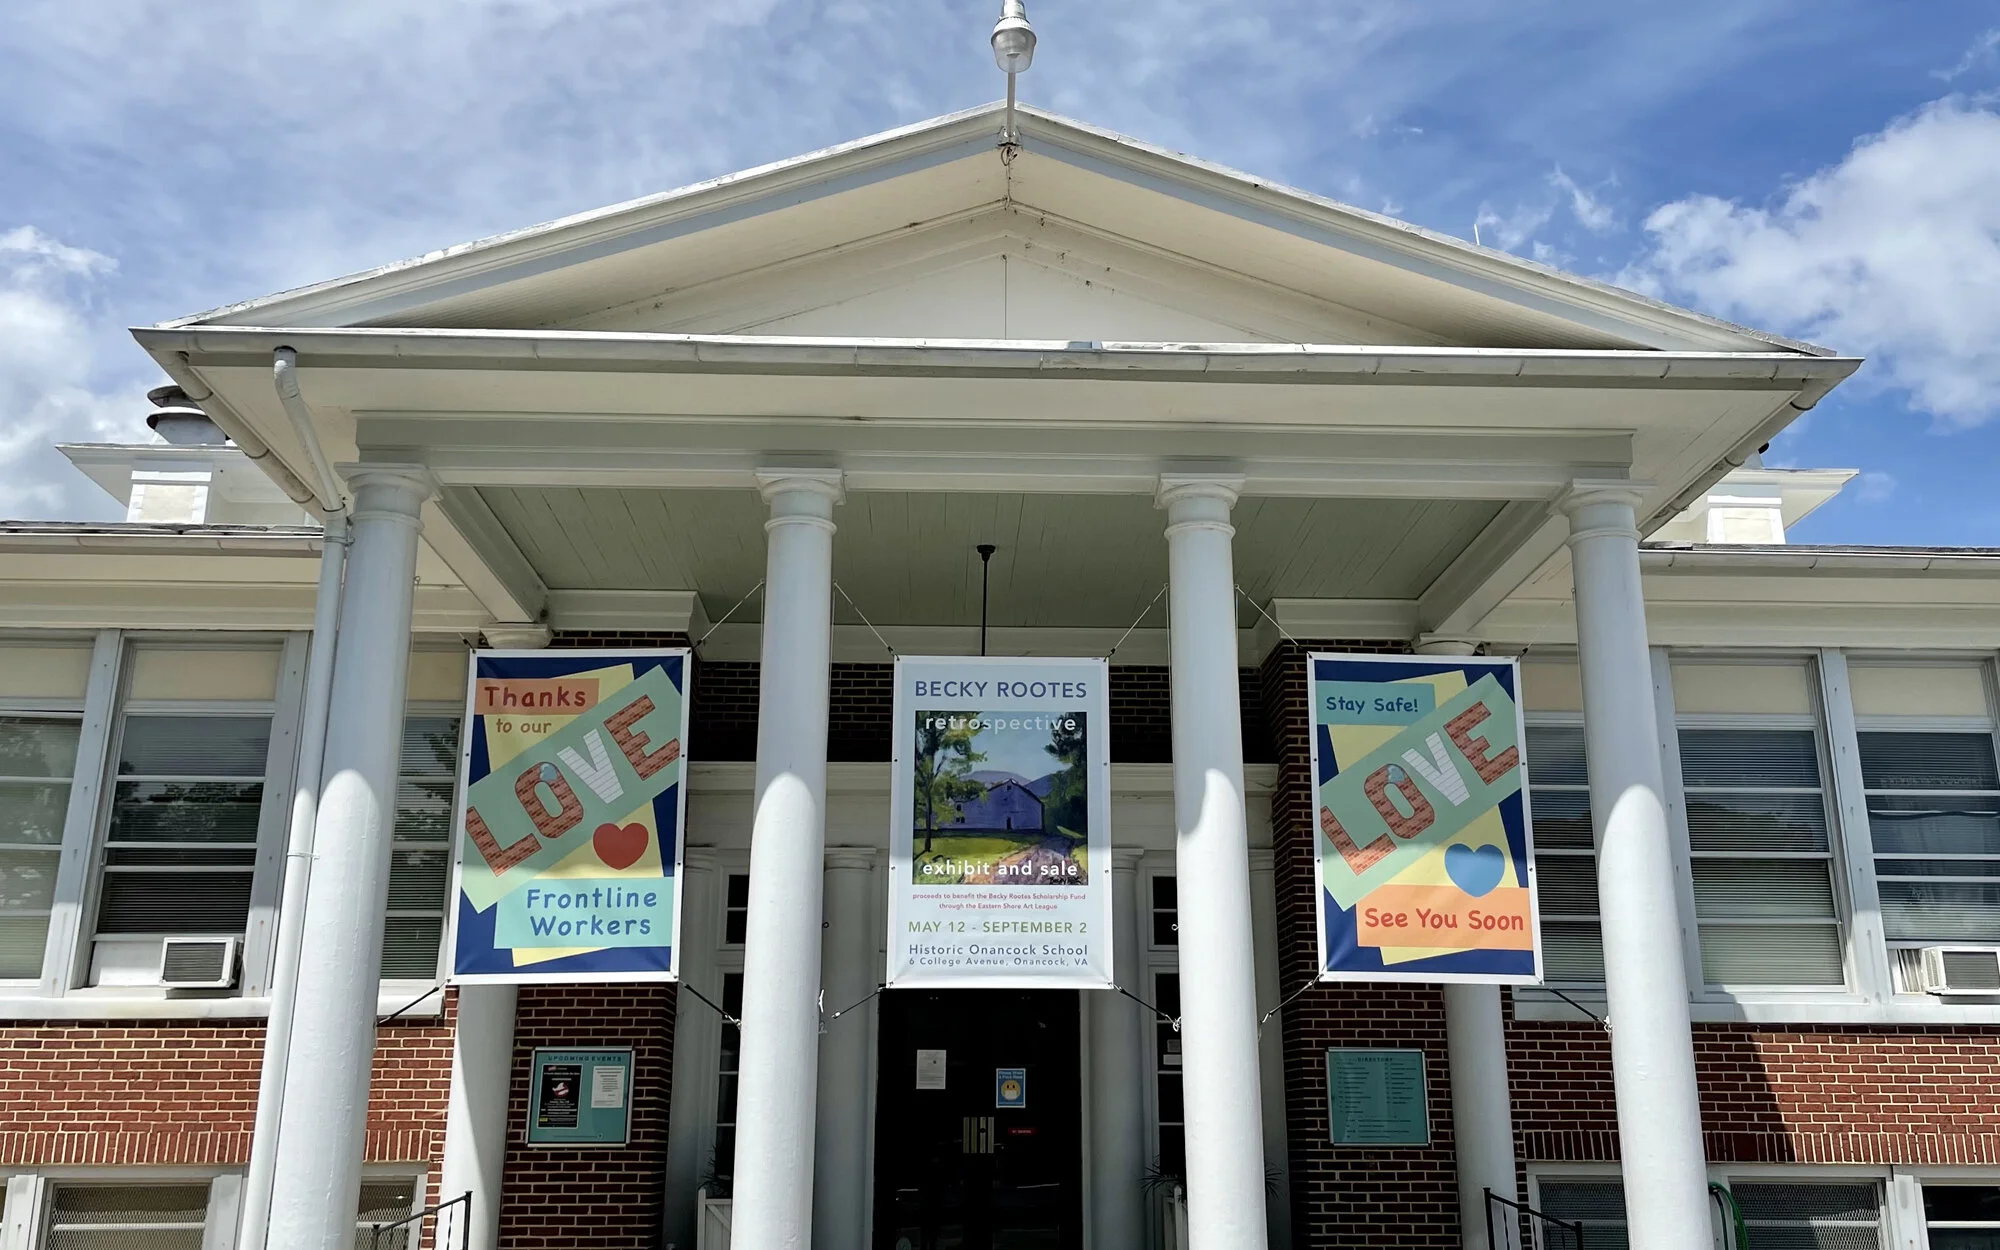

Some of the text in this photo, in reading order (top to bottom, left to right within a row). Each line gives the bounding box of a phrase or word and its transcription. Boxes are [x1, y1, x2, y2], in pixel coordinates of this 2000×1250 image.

[484, 686, 586, 707] Thanks
[915, 680, 1087, 698] BECKY ROOTES
[1326, 696, 1418, 714] Stay Safe!
[496, 718, 552, 733] to our
[925, 715, 1076, 734] retrospective
[465, 694, 680, 877] LOVE
[1320, 701, 1519, 876] LOVE
[922, 860, 1078, 876] exhibit and sale
[527, 887, 657, 909] Frontline
[1032, 893, 1068, 901] Scholarship
[530, 914, 651, 936] Workers
[908, 921, 942, 933] MAY
[948, 921, 965, 933] 12
[983, 921, 1073, 934] SEPTEMBER
[1079, 922, 1087, 933] 2
[1365, 908, 1524, 931] See You Soon
[909, 944, 1088, 956] Historic Onancock School
[919, 957, 961, 967] College
[965, 957, 1009, 967] Avenue,
[1013, 957, 1069, 967] Onancock,
[1074, 958, 1088, 966] VA
